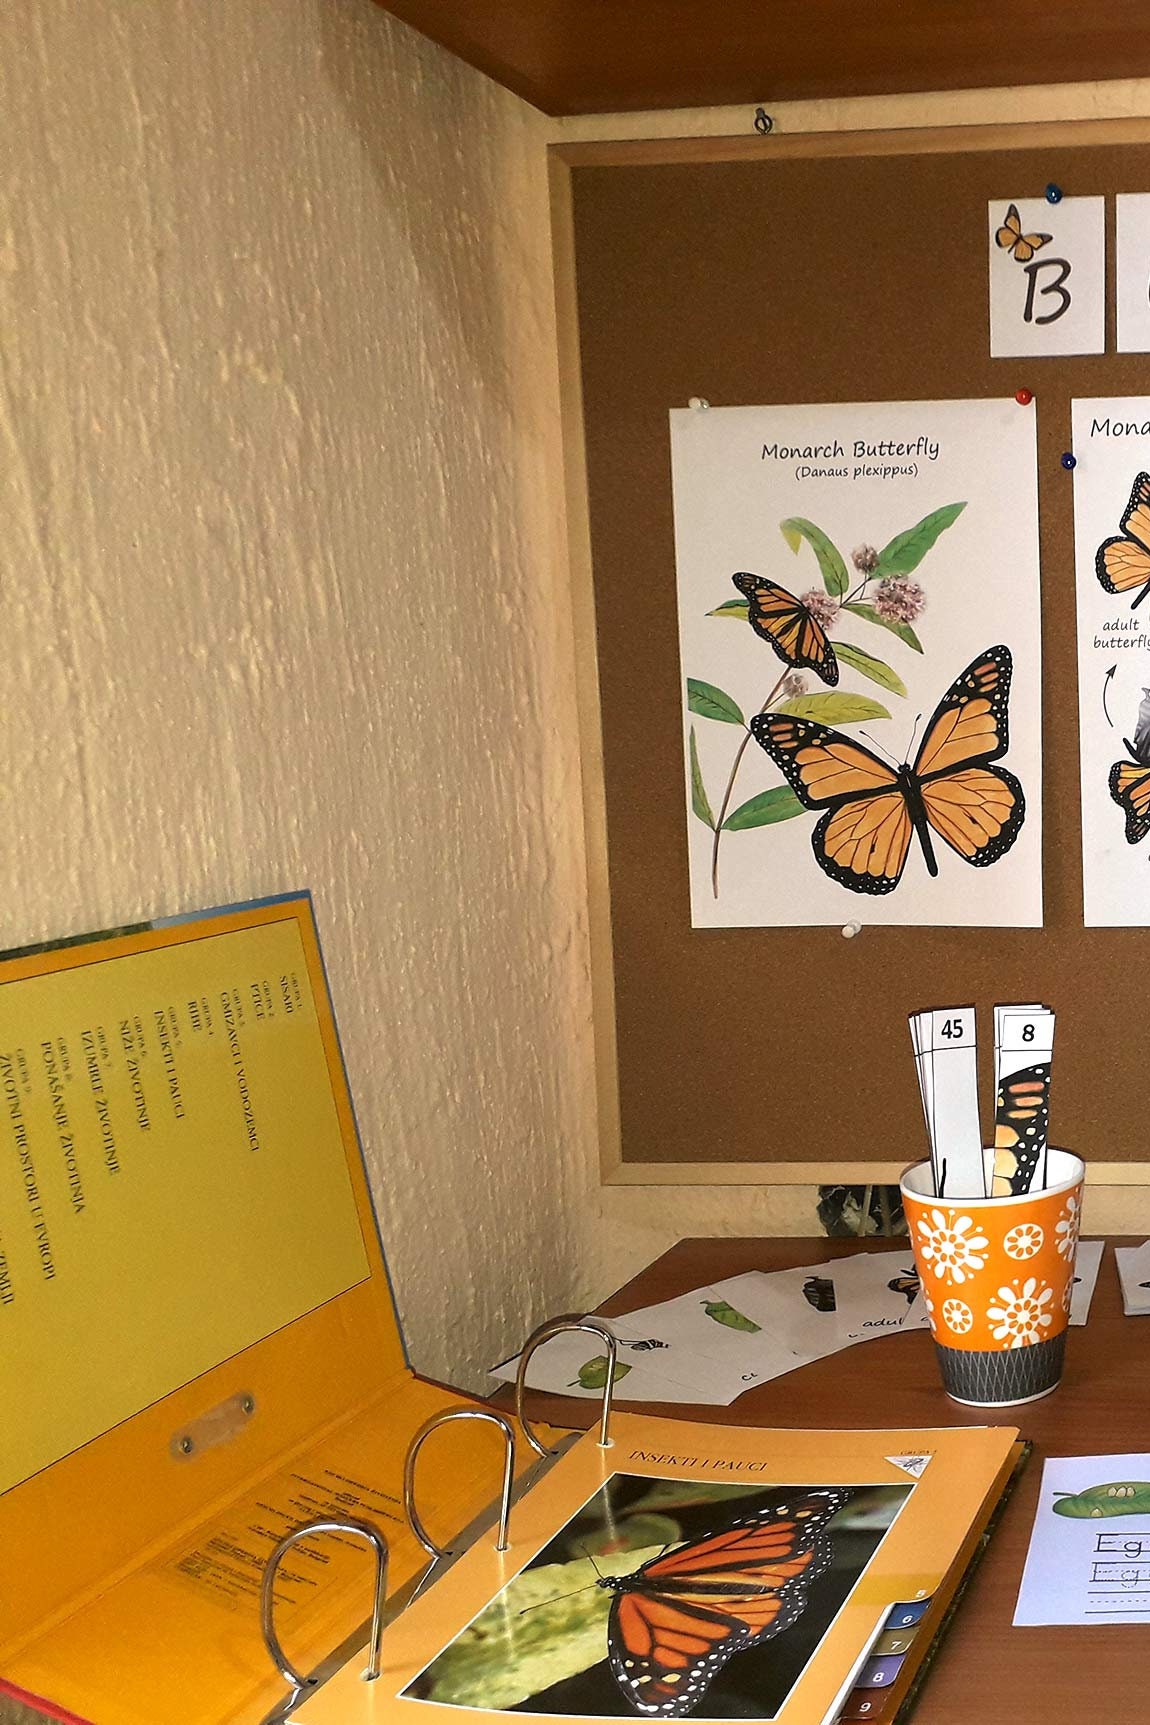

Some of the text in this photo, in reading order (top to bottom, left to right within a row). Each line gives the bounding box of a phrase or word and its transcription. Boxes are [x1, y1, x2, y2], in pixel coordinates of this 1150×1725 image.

[761, 436, 940, 460] Monarch Butterfly
[795, 462, 919, 480] (Danaus plexippus)
[1102, 619, 1140, 631] adult
[279, 975, 293, 1014] SISARI
[941, 1019, 963, 1039] 45
[1022, 1024, 1035, 1042] 8
[862, 1317, 903, 1327] adul
[629, 1451, 697, 1466] INSEKTI
[712, 1460, 768, 1471] PAUCI
[902, 1615, 913, 1623] 6
[891, 1641, 902, 1650] 7
[873, 1673, 884, 1682] 8
[860, 1702, 872, 1712] 9
